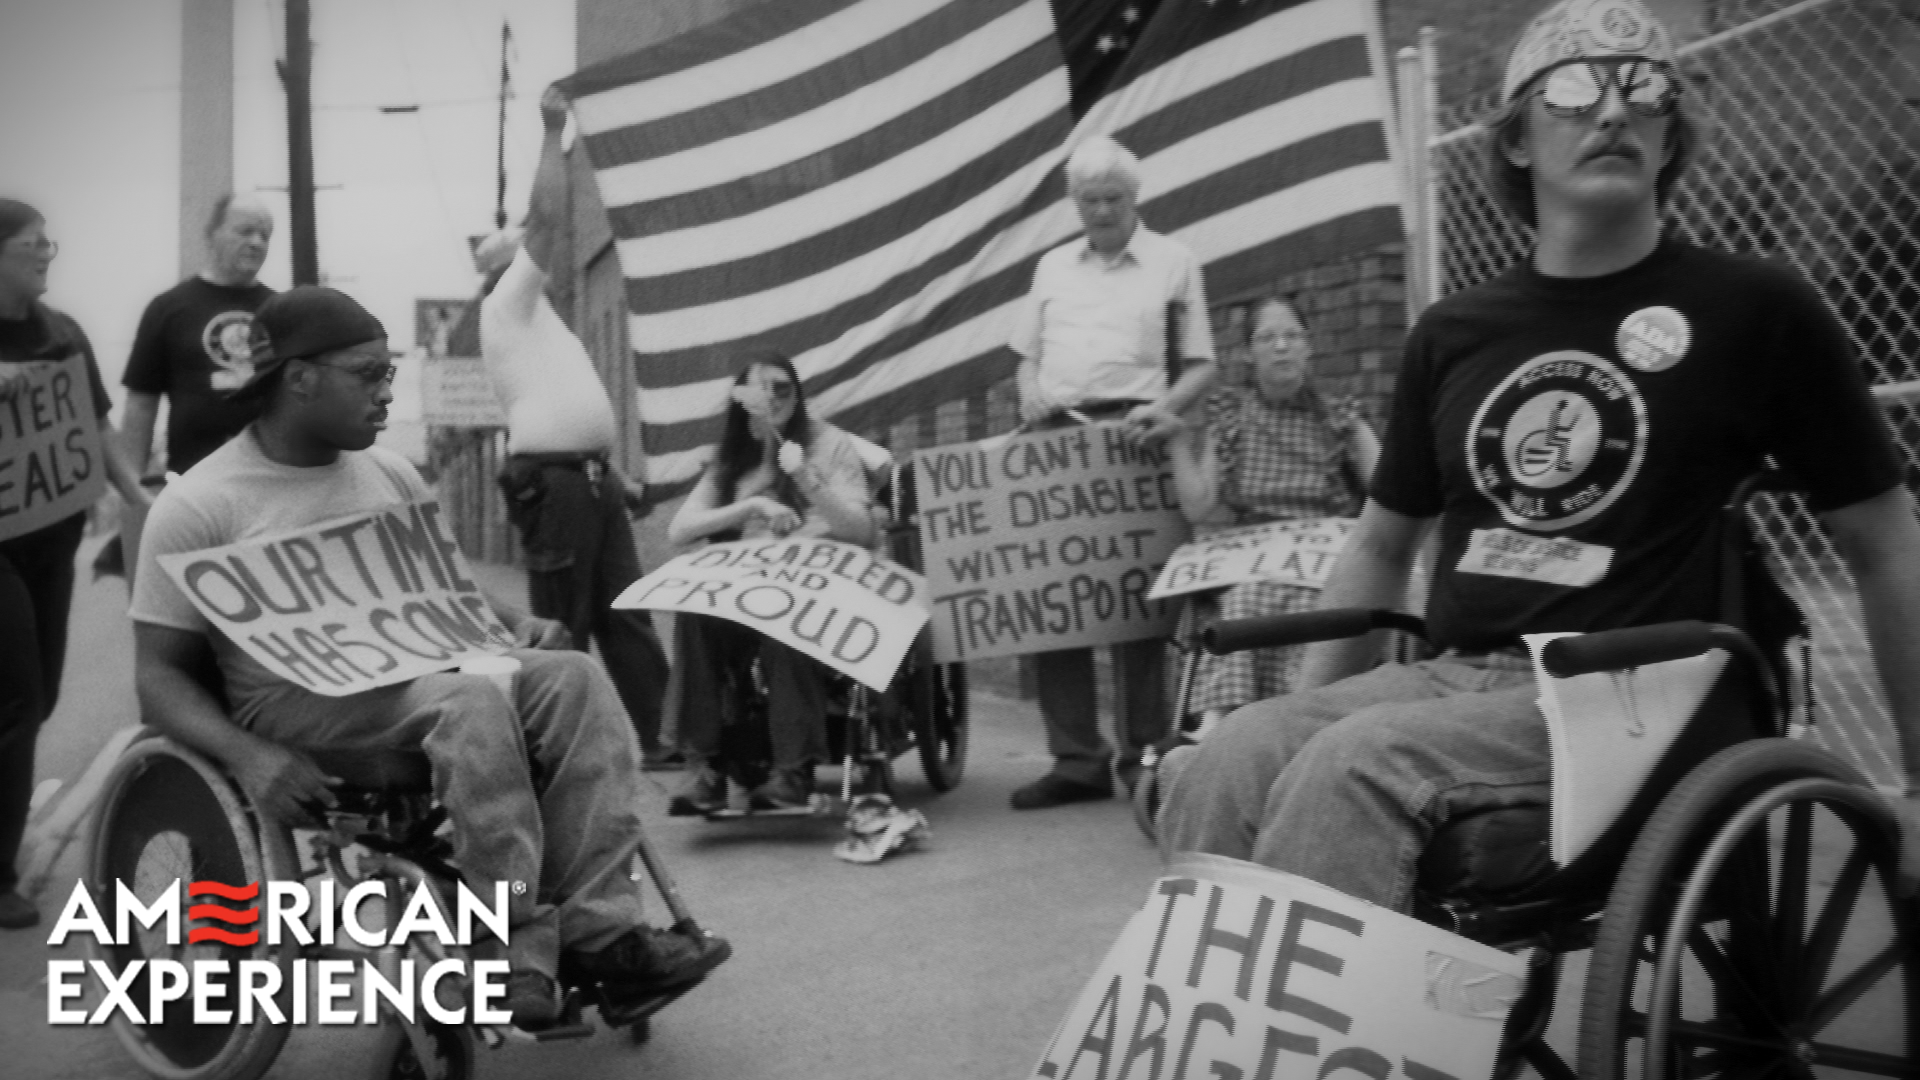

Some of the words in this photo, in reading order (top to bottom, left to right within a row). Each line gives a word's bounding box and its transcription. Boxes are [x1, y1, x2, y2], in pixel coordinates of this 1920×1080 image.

[0, 371, 77, 438] TER
[1517, 363, 1584, 390] ACCESS
[1586, 370, 1625, 401] NOW
[921, 450, 991, 498] YOU
[1560, 482, 1605, 514] RIDE
[923, 500, 992, 543] THE
[184, 536, 358, 624] OUR
[318, 501, 479, 600] TIME
[687, 543, 916, 606] DISABLED
[740, 568, 831, 591] AND
[946, 539, 1051, 583] WITH
[1058, 529, 1157, 566] OUT
[1164, 555, 1227, 590] BE
[1248, 551, 1335, 582] LAT
[637, 577, 881, 664] PROUD
[248, 622, 399, 687] HAS
[1143, 877, 1366, 1035] THE
